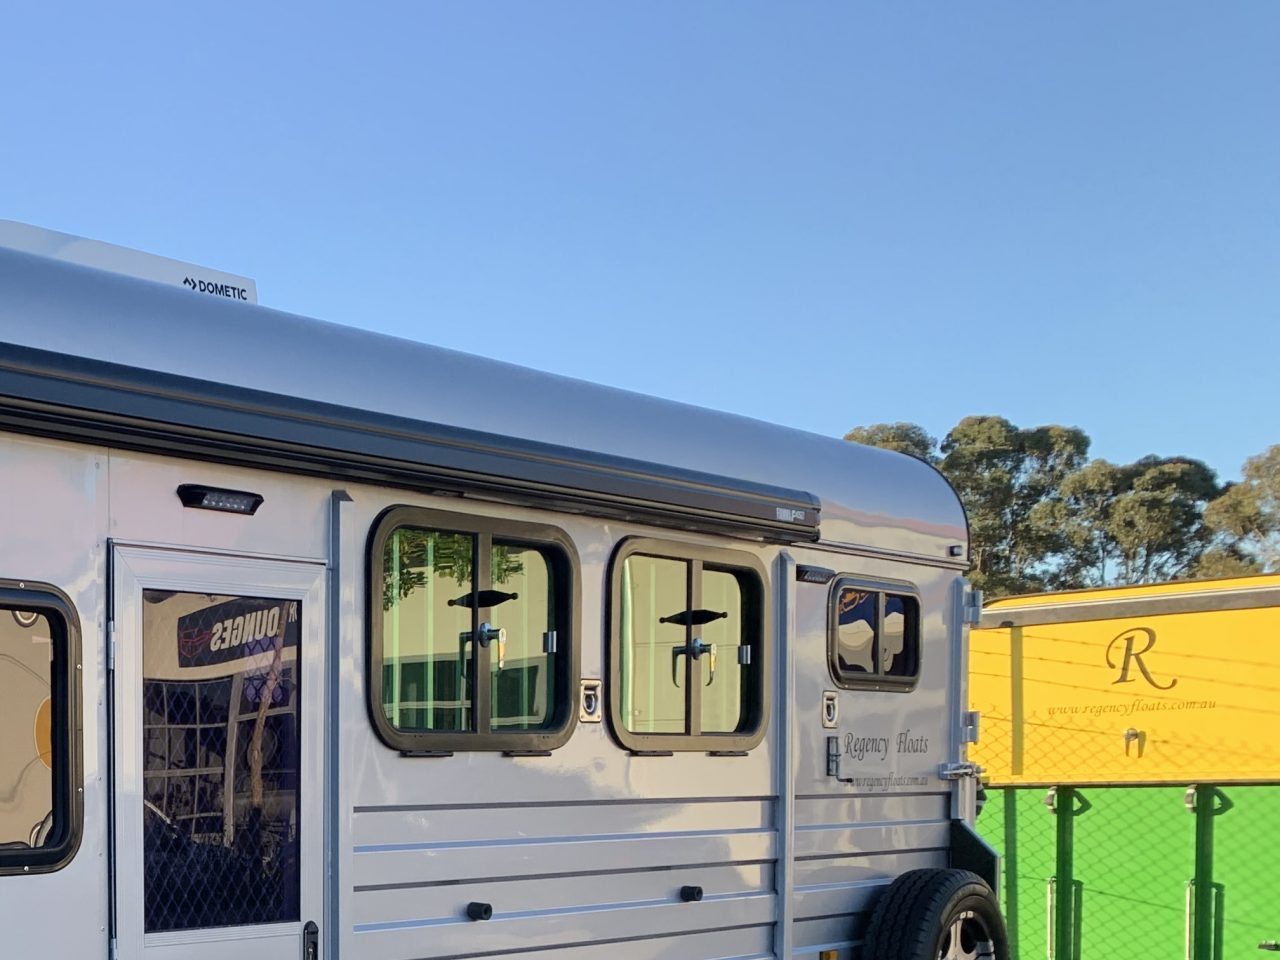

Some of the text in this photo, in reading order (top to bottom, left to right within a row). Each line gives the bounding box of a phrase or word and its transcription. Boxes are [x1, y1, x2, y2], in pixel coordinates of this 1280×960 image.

[198, 279, 247, 301] DOMETIC
[1105, 626, 1179, 690] R
[1048, 699, 1217, 717] www.regencyfloats.com.au
[843, 729, 929, 761] Regency Floats
